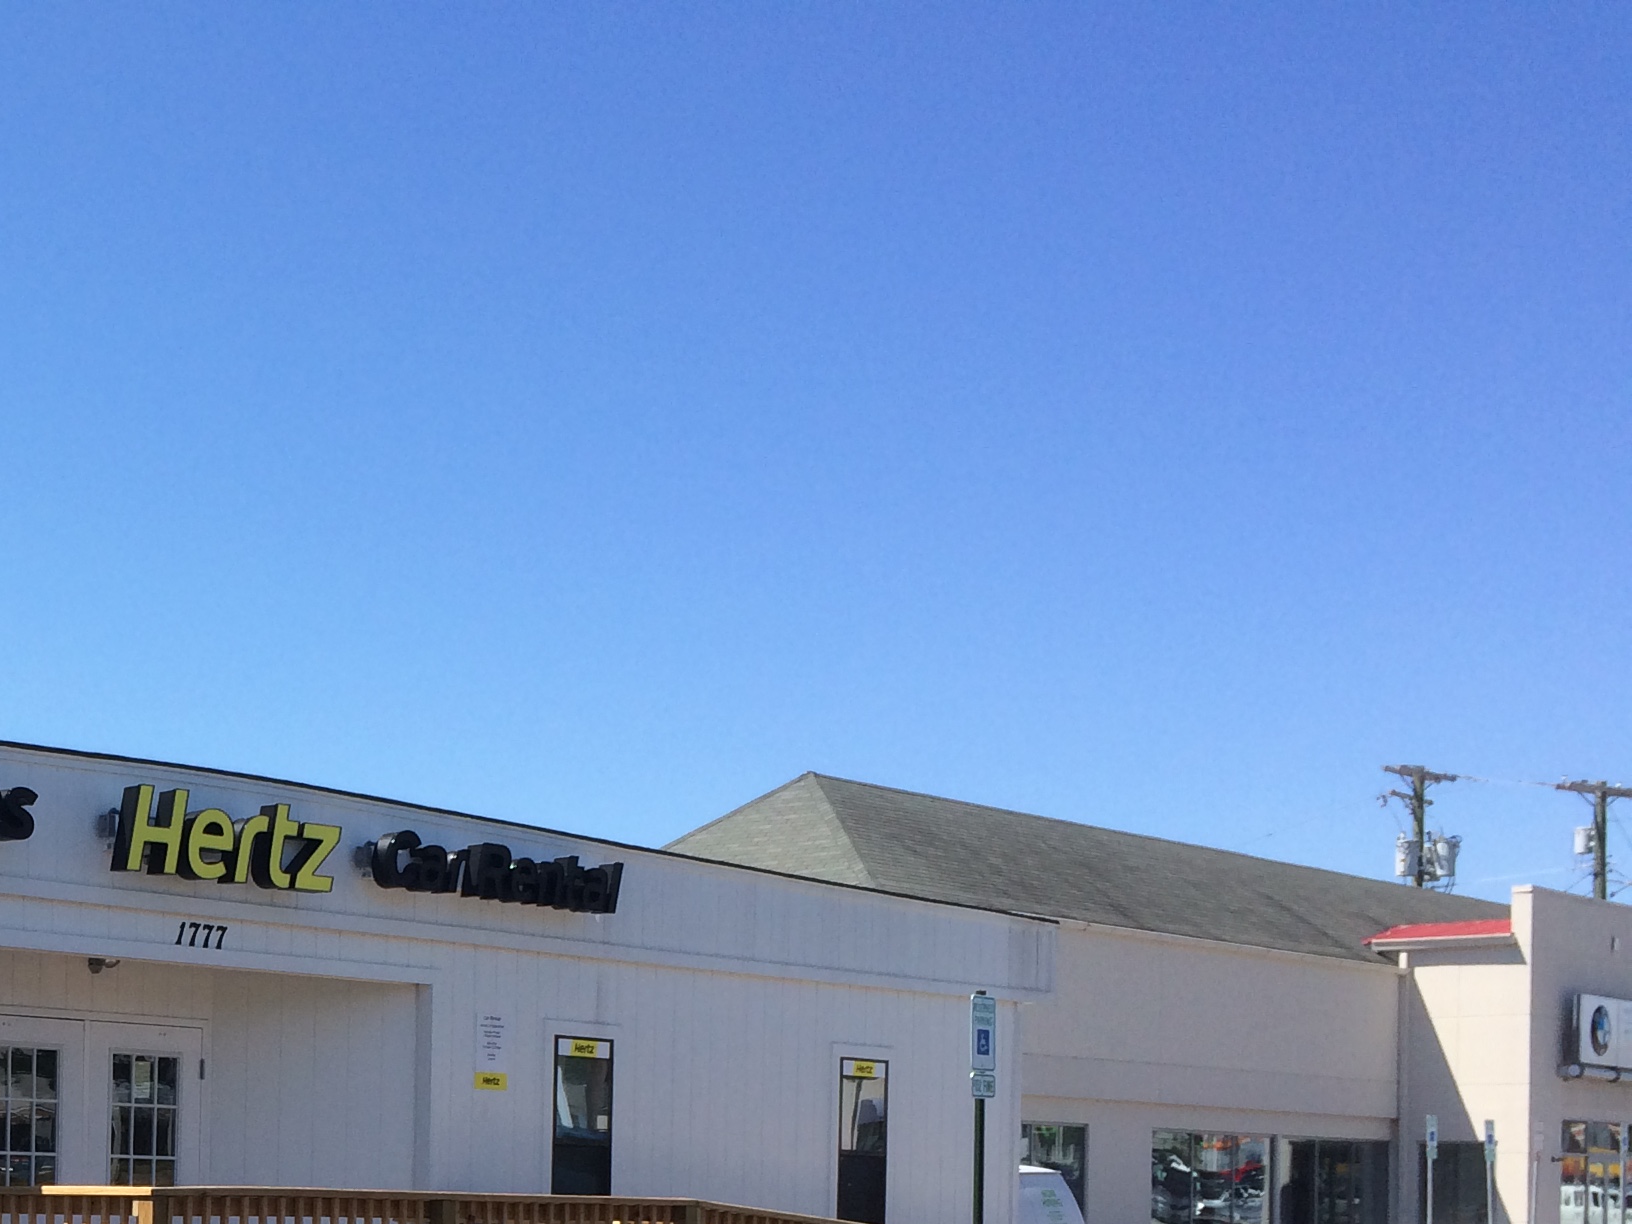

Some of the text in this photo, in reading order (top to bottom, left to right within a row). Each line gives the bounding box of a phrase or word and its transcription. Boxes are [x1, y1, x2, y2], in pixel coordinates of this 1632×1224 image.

[112, 783, 343, 893] Hertz
[372, 830, 624, 914] Car Rental
[175, 921, 228, 950] 1777
[574, 1042, 595, 1054] Hertz
[482, 1076, 500, 1086] Hertz
